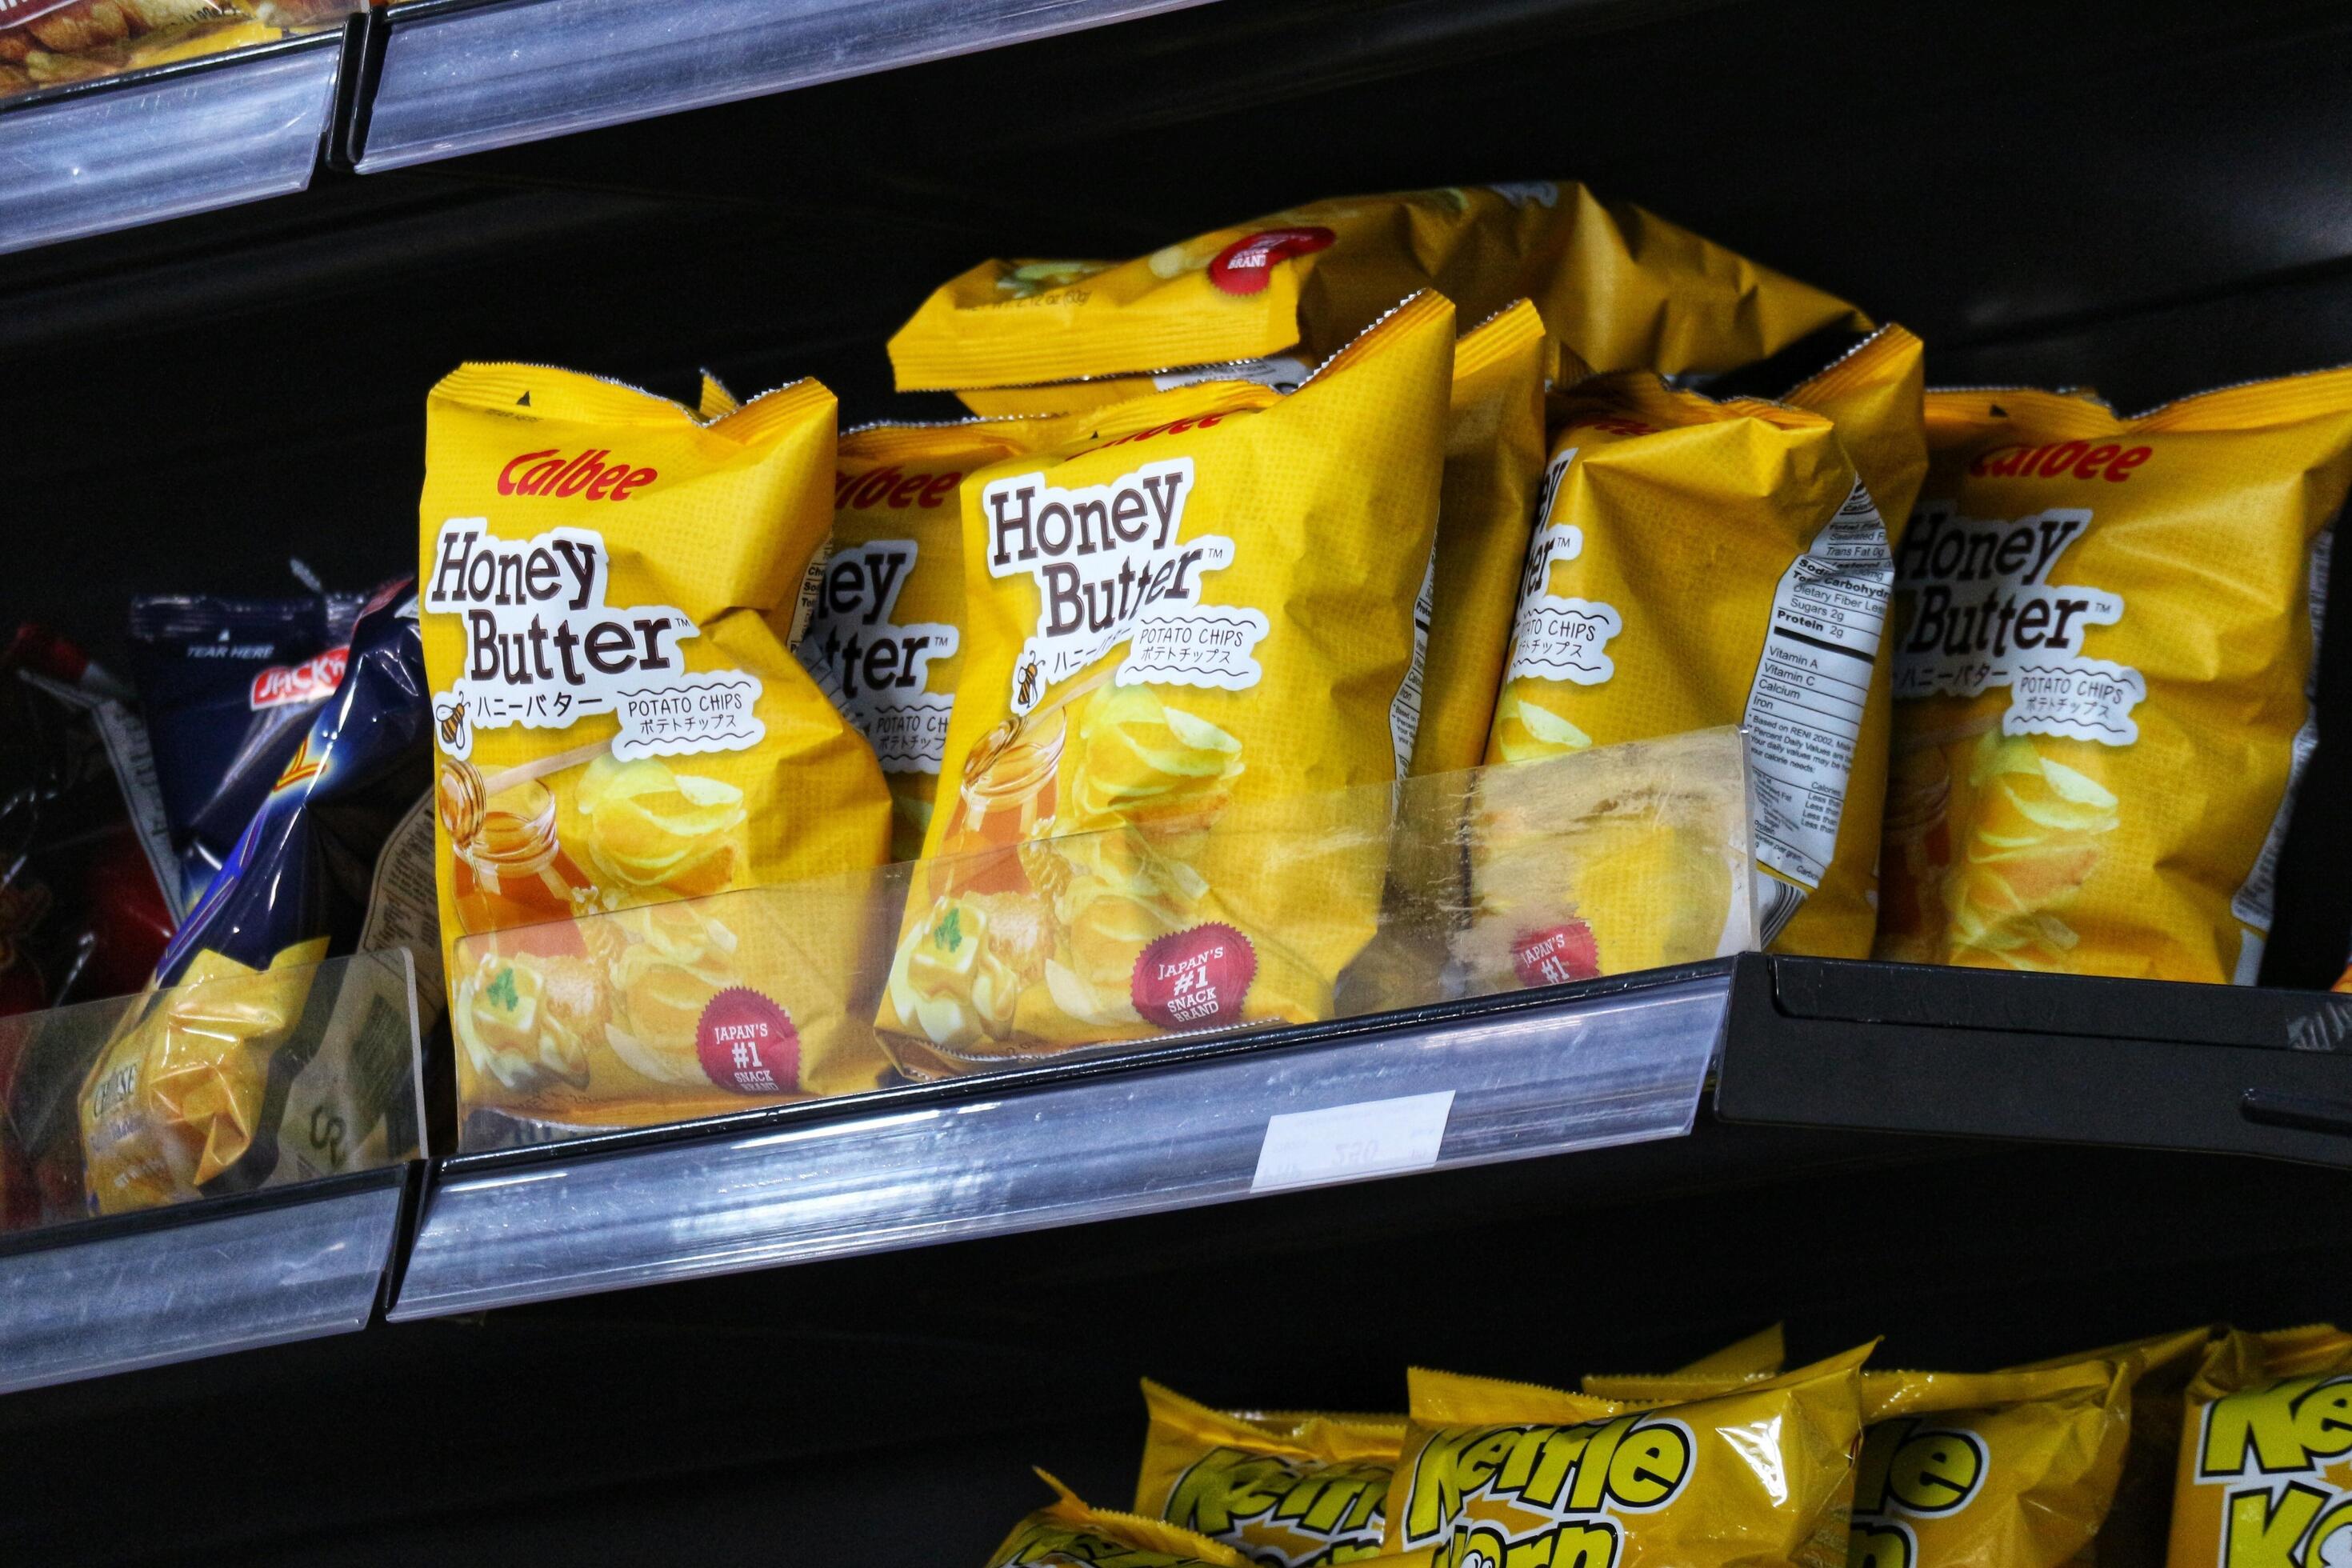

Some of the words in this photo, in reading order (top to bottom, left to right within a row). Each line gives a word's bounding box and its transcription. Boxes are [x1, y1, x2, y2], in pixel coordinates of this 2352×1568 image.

[498, 449, 658, 502] Calbee
[834, 464, 963, 510] lbee
[990, 472, 1183, 566] Honey
[1826, 546, 1851, 557] Trans
[1854, 546, 1871, 556] Fat
[1896, 510, 2080, 586] Honey
[431, 530, 597, 610] Honey
[1042, 547, 1202, 638] Butter
[1793, 584, 1831, 602] Dietary
[1834, 594, 1863, 609] Fiber
[1865, 602, 1883, 614] Les
[1824, 577, 1890, 598] Carbohydr
[1790, 598, 1828, 616] Sugars
[1830, 609, 1845, 622] 2g
[1907, 586, 2088, 658] Butter
[1548, 620, 1596, 642] CHIPS
[1778, 610, 1824, 632] Protein
[1830, 626, 1844, 639] 2g
[468, 609, 671, 686] Butter
[1138, 627, 1192, 644] POTATO
[1199, 628, 1244, 647] CHIPS
[186, 645, 228, 658] TEAR
[230, 645, 274, 659] HERE
[1141, 646, 1231, 664] ポテトチップス
[1769, 645, 1808, 666] Vitamin
[1810, 659, 1818, 670] A
[1764, 662, 1803, 683] Vitamin
[1806, 676, 1816, 686] C
[1758, 678, 1801, 700] Calcium
[2019, 677, 2071, 694] POTATO
[2077, 680, 2123, 704] CHIPS
[477, 690, 603, 719] ハニーバター
[628, 697, 692, 718] POTATO
[699, 693, 742, 712] CHIPS
[1753, 695, 1774, 710] Iron
[2025, 697, 2110, 718] ポテトチップス
[639, 714, 736, 735] ポテトチップス
[877, 716, 921, 734] POTATO
[1753, 715, 1778, 730] Based
[1778, 724, 1788, 733] on
[1754, 726, 1782, 742] Percent
[1784, 736, 1804, 750] Daily
[1767, 741, 1785, 754] daily
[1813, 755, 1830, 767] may
[1805, 801, 1823, 813] Less
[1807, 792, 1826, 804] Less
[1801, 818, 1818, 830] Less
[1802, 810, 1821, 822] Less
[1158, 946, 1223, 980] JAPAN'S
[1521, 934, 1565, 969] JAPAN'S
[1174, 965, 1209, 997] #1
[1541, 955, 1570, 985] #1
[1167, 986, 1217, 1013] SNACK
[1173, 1001, 1219, 1022] BRAND
[714, 1023, 768, 1045] JAPAN'S
[731, 1042, 762, 1069] #1
[734, 1070, 774, 1082] SNACK
